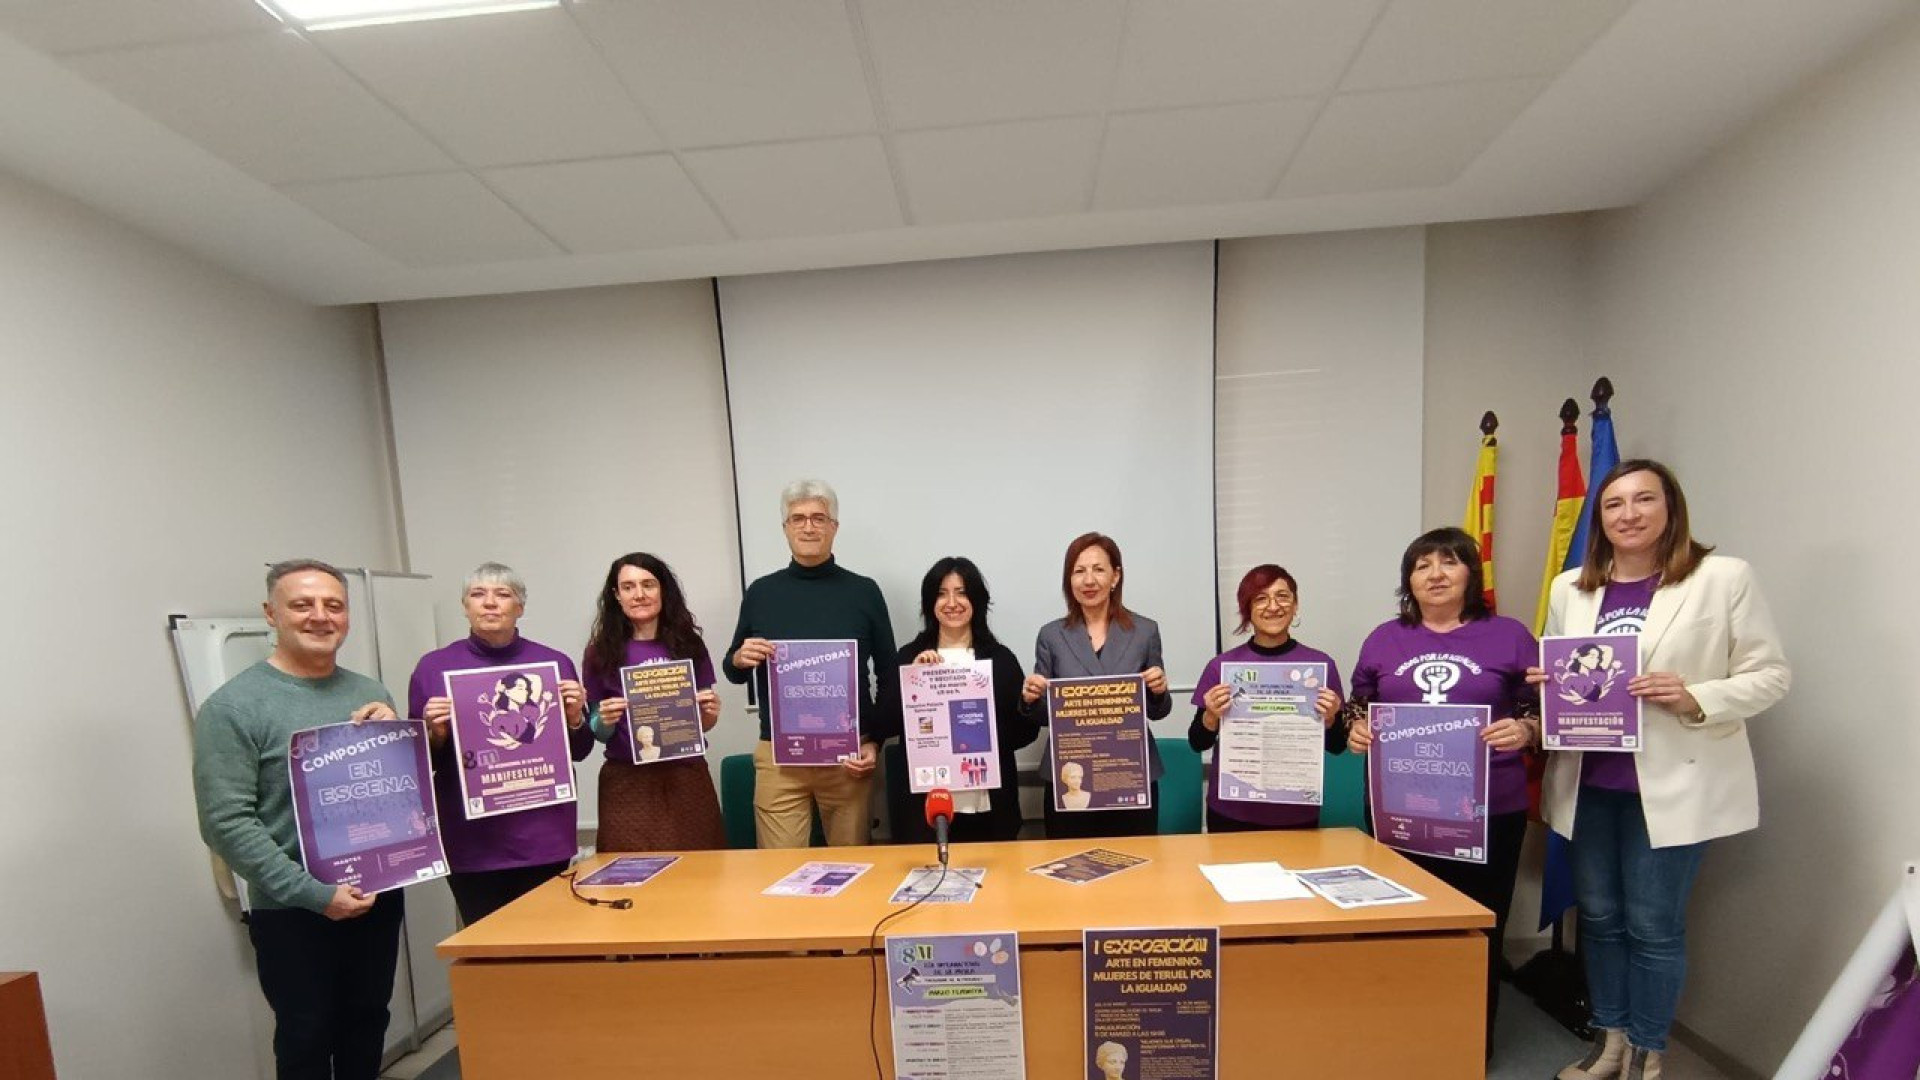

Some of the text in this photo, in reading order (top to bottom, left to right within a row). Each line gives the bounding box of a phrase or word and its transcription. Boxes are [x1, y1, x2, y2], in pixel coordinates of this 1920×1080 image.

[1605, 607, 1624, 620] POR
[1626, 607, 1640, 616] LA
[776, 649, 852, 674] COMPOSITORAS
[804, 672, 826, 684] EN
[784, 684, 846, 698] ESCENA
[1056, 681, 1136, 698] I EXPOSICIÓN
[1056, 705, 1140, 718] MUJERES DE TERUEL POR
[1064, 700, 1082, 708] ARTE
[1086, 717, 1124, 726] IGUALDAD
[1558, 716, 1624, 726] MANIFESTACIÓN
[1379, 716, 1480, 743] COMPOSITORAS
[302, 727, 418, 772] COMPOSITORAS
[1416, 742, 1444, 758] EN
[348, 759, 382, 779] EN
[481, 763, 554, 784] MANIFESTACIÓN
[1388, 758, 1472, 776] ESCENA
[319, 775, 417, 806] ESCENA
[1094, 936, 1208, 954] I EXPOSICIÓN
[902, 946, 932, 964] 8M
[1106, 956, 1202, 968] ARTE EN FEMENINO:
[1094, 968, 1212, 981] MUJERES DE TERUEL POR
[1121, 984, 1187, 994] LA IGUALDAD
